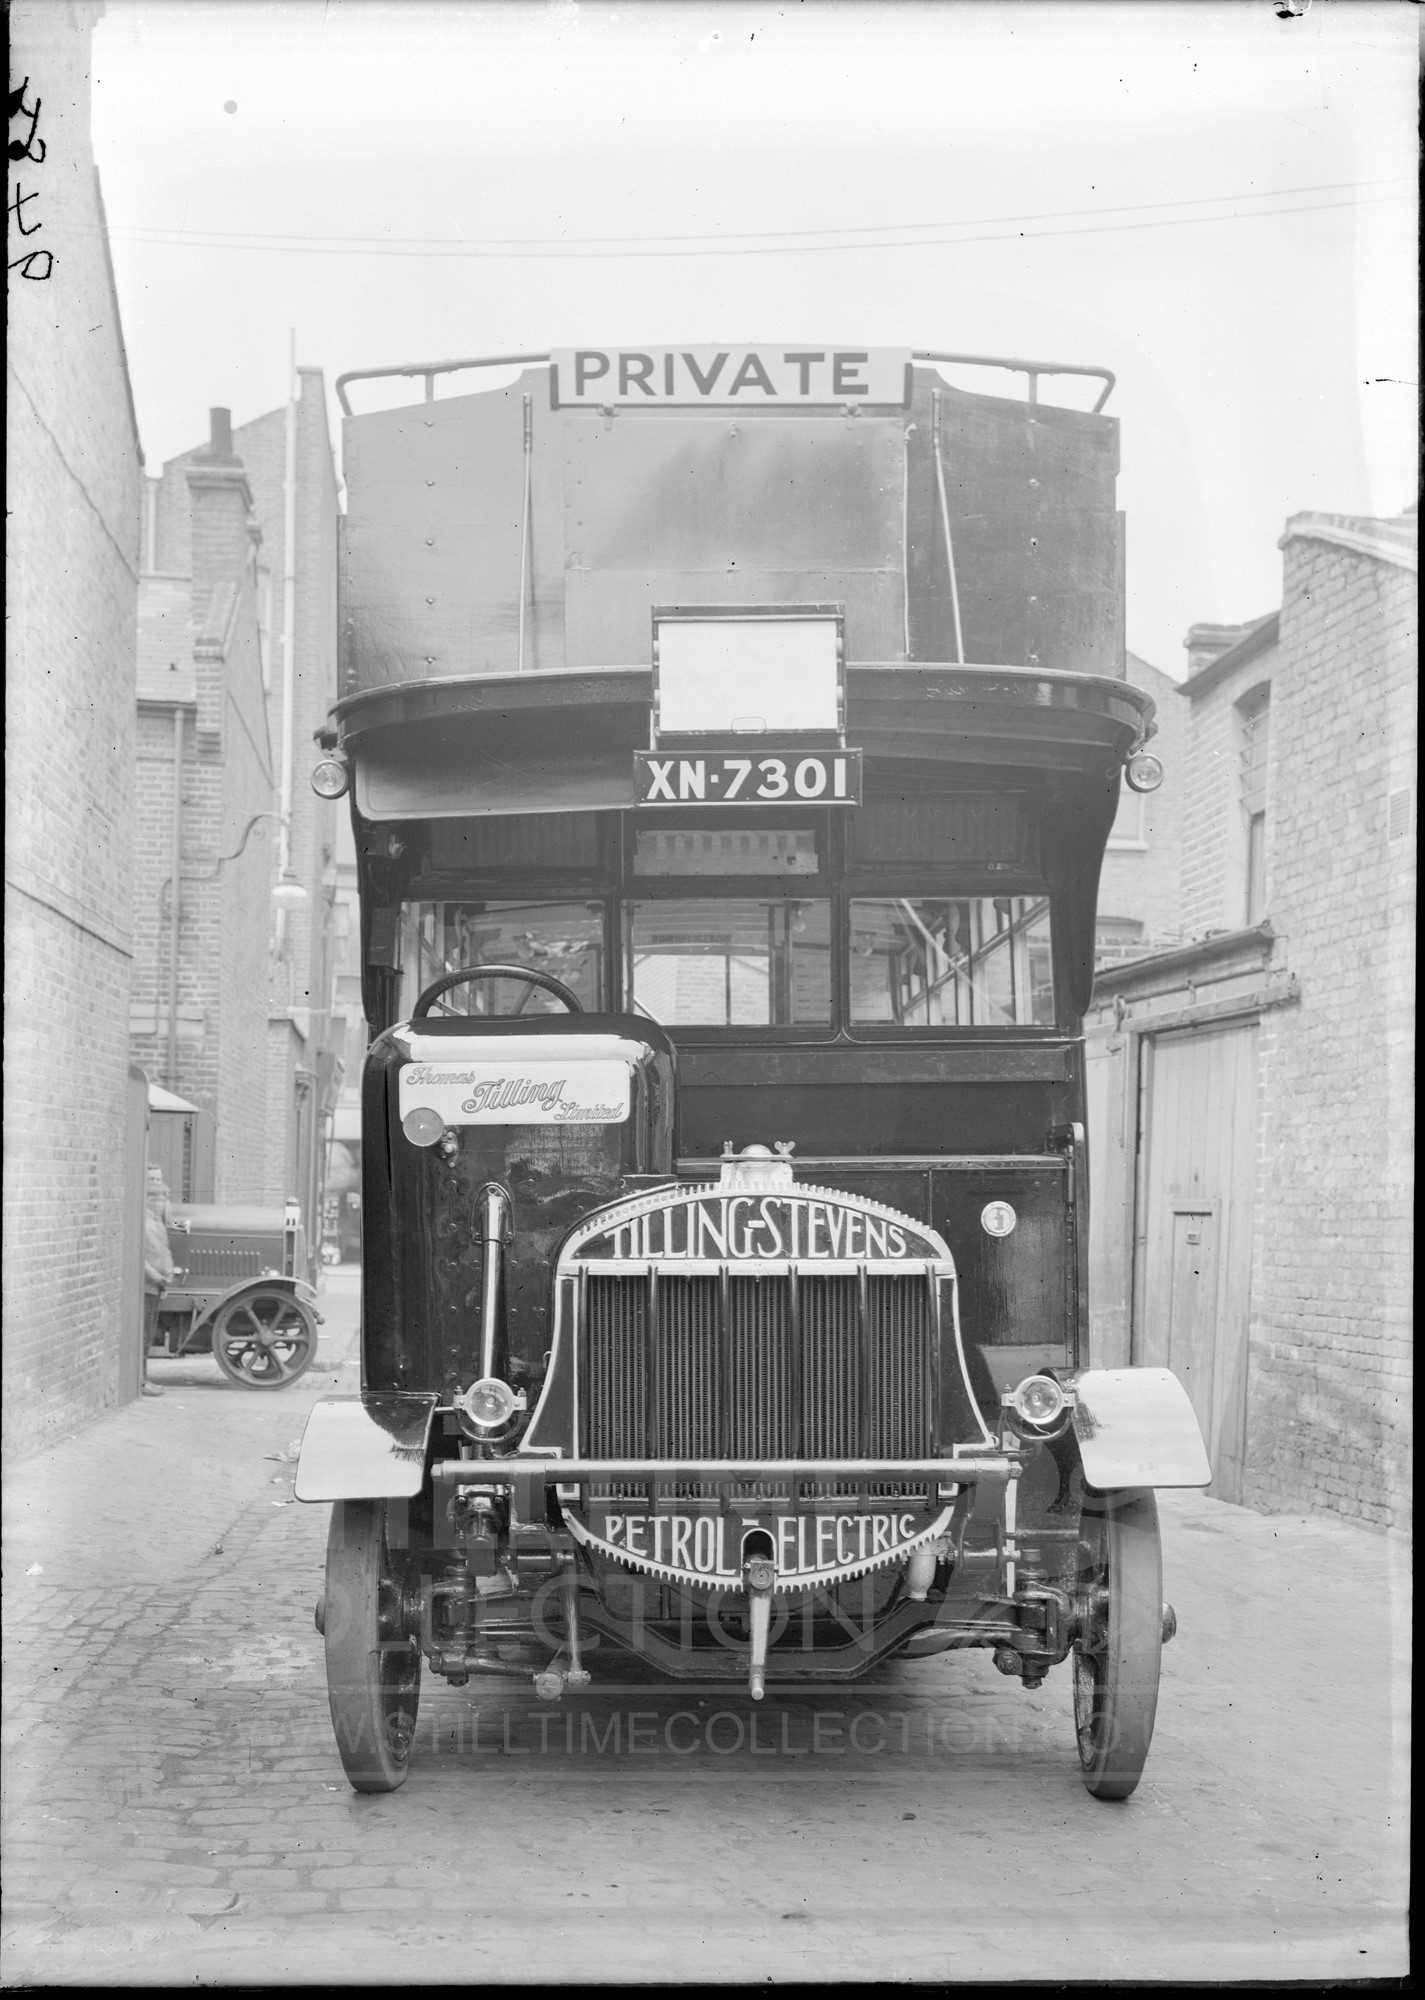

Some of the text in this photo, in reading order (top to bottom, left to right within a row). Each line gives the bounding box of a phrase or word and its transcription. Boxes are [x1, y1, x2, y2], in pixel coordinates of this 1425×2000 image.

[574, 350, 869, 396] PRIVATE
[405, 1065, 625, 1121] Thomas Tilling Limited
